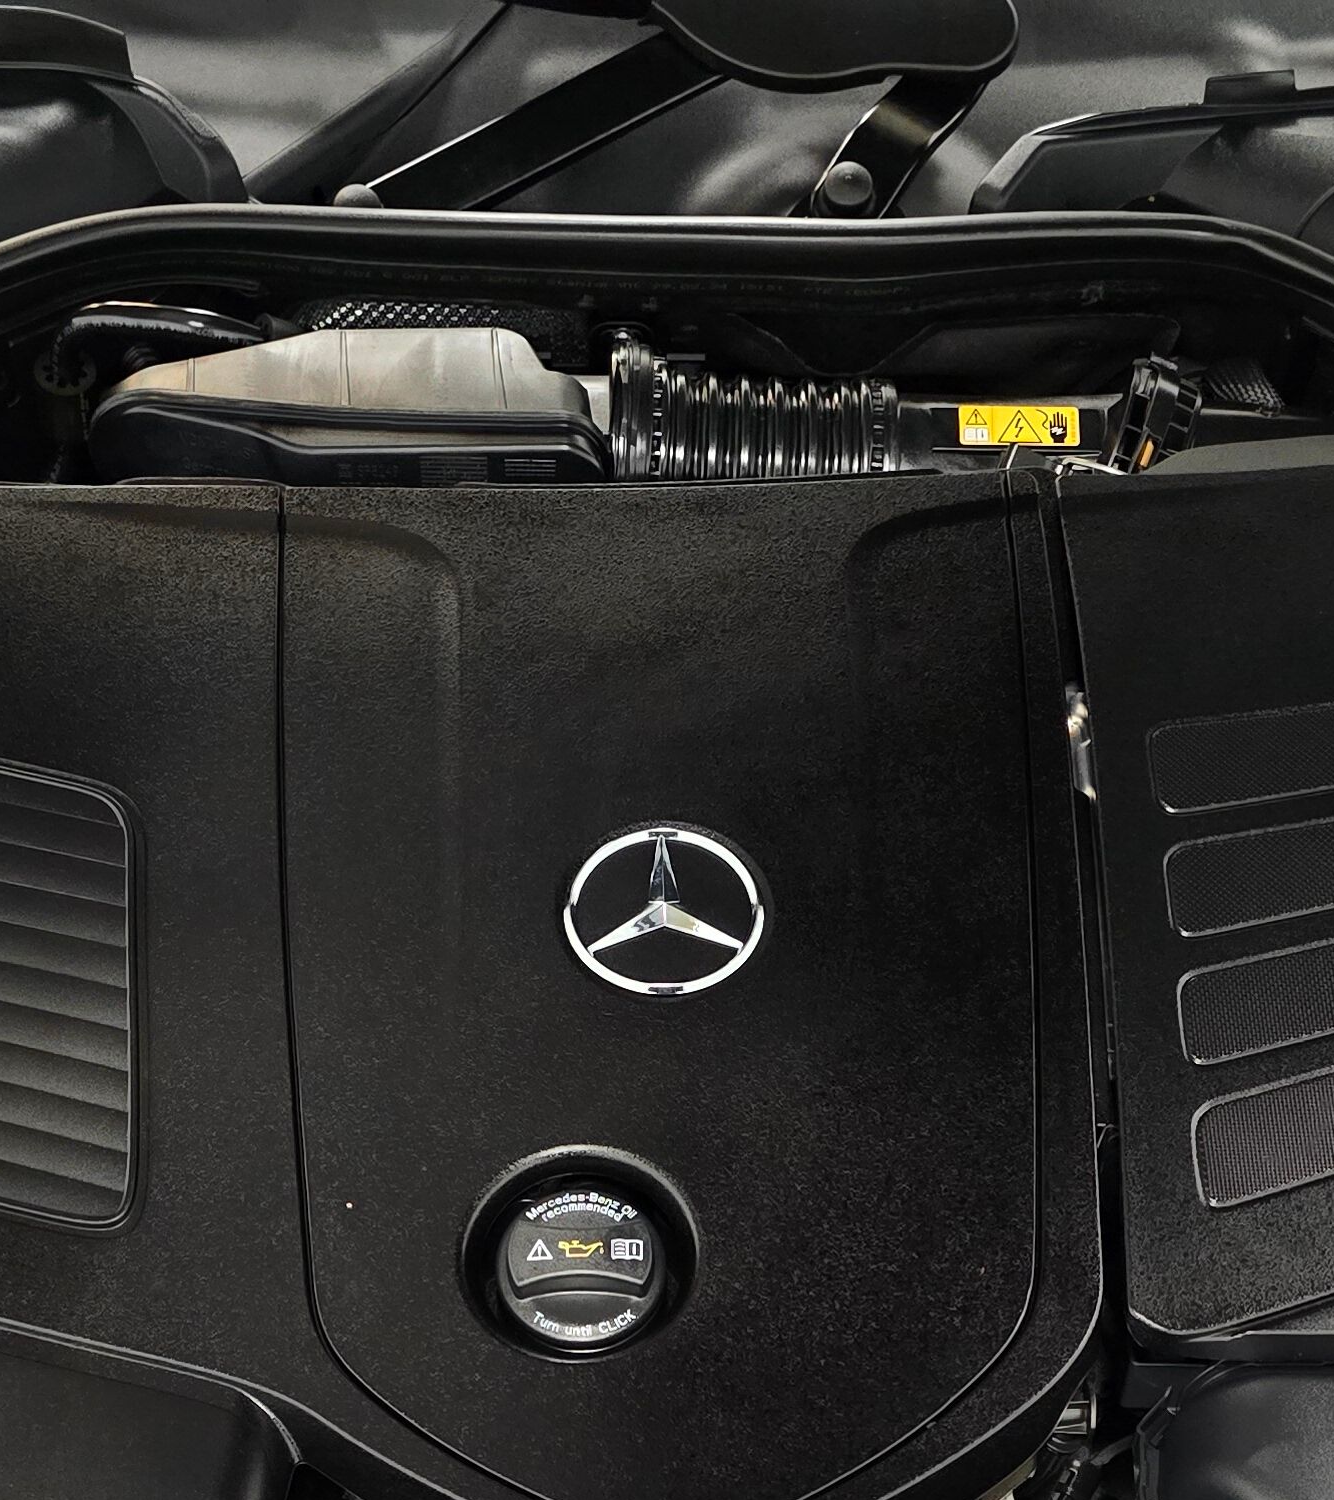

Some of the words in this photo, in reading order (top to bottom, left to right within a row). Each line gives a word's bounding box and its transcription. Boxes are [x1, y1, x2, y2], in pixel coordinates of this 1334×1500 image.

[525, 1192, 620, 1220] Mercedes-Benz
[621, 1205, 638, 1220] Oil
[541, 1202, 625, 1222] recommended
[533, 1311, 560, 1333] Turn
[564, 1324, 592, 1337] until
